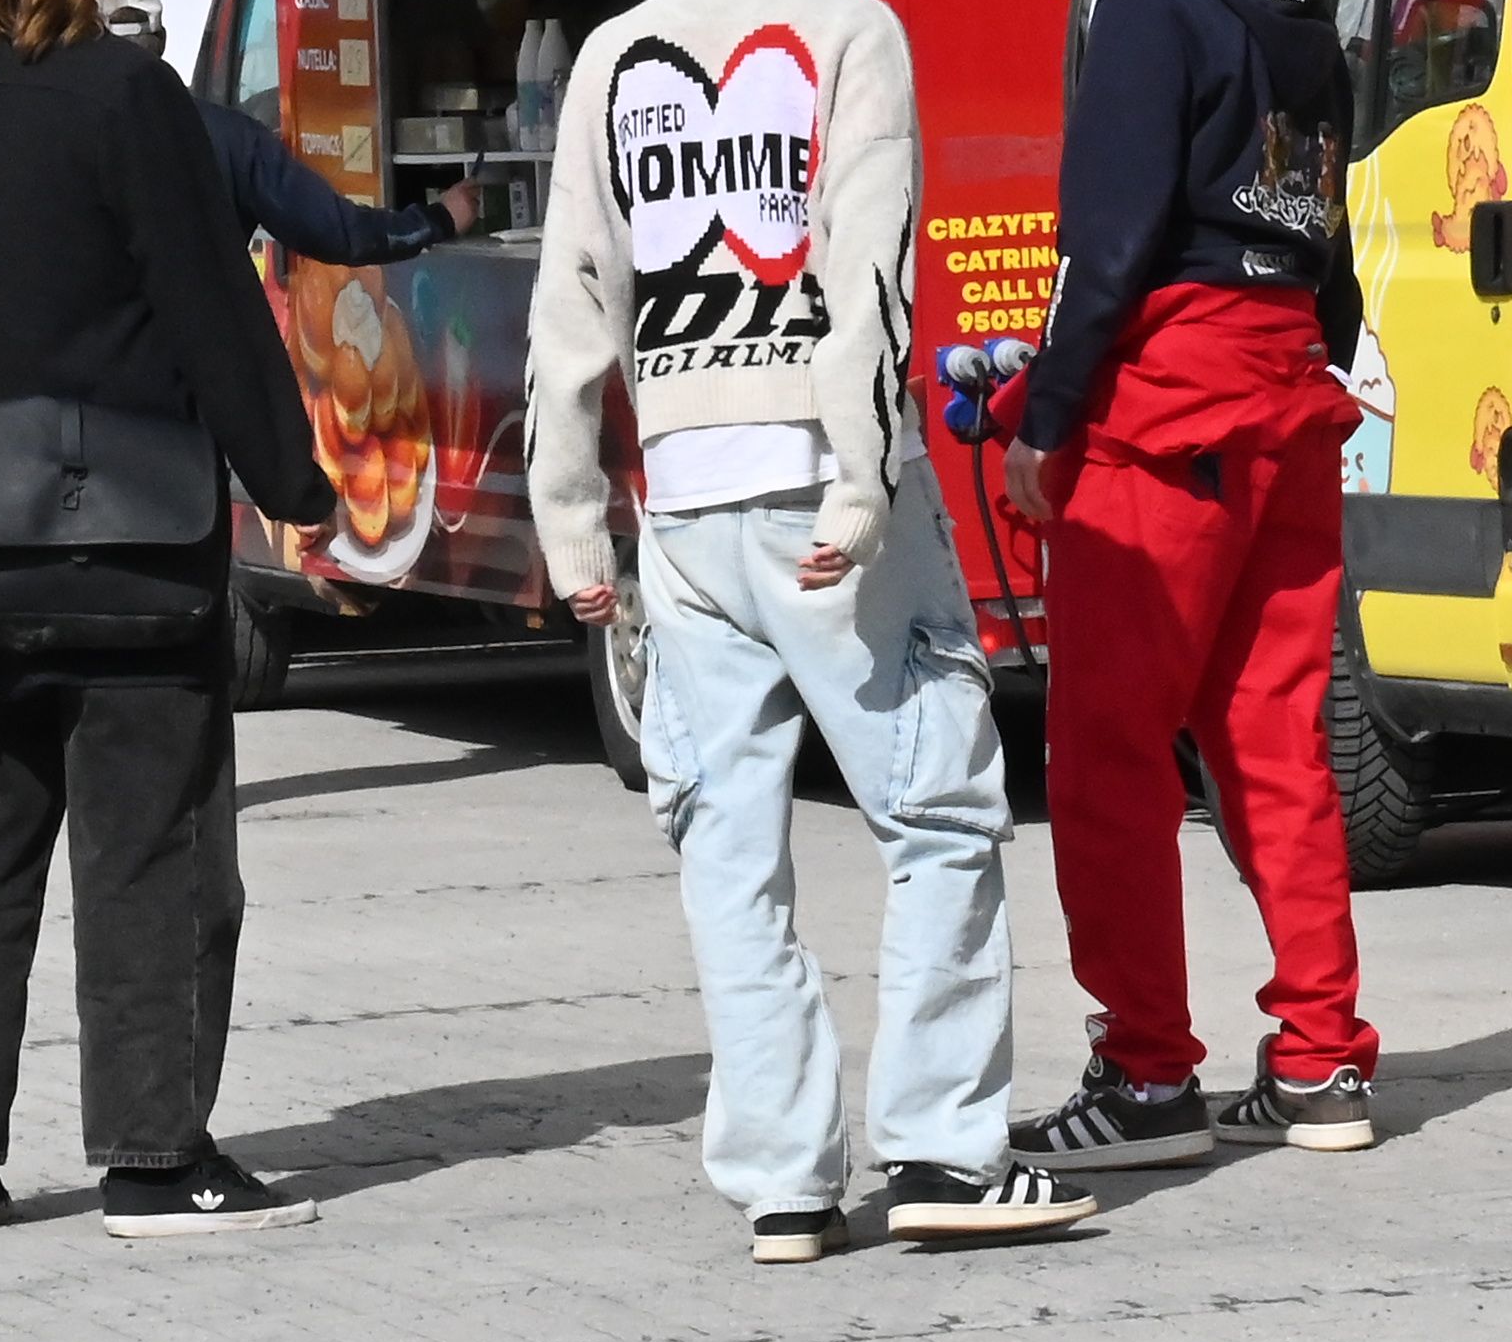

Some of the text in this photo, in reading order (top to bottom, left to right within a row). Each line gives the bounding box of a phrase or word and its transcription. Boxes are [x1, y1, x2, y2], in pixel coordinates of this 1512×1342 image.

[626, 133, 810, 203] OMME
[962, 277, 1052, 303] CALL U
[957, 307, 1047, 333] 95035
